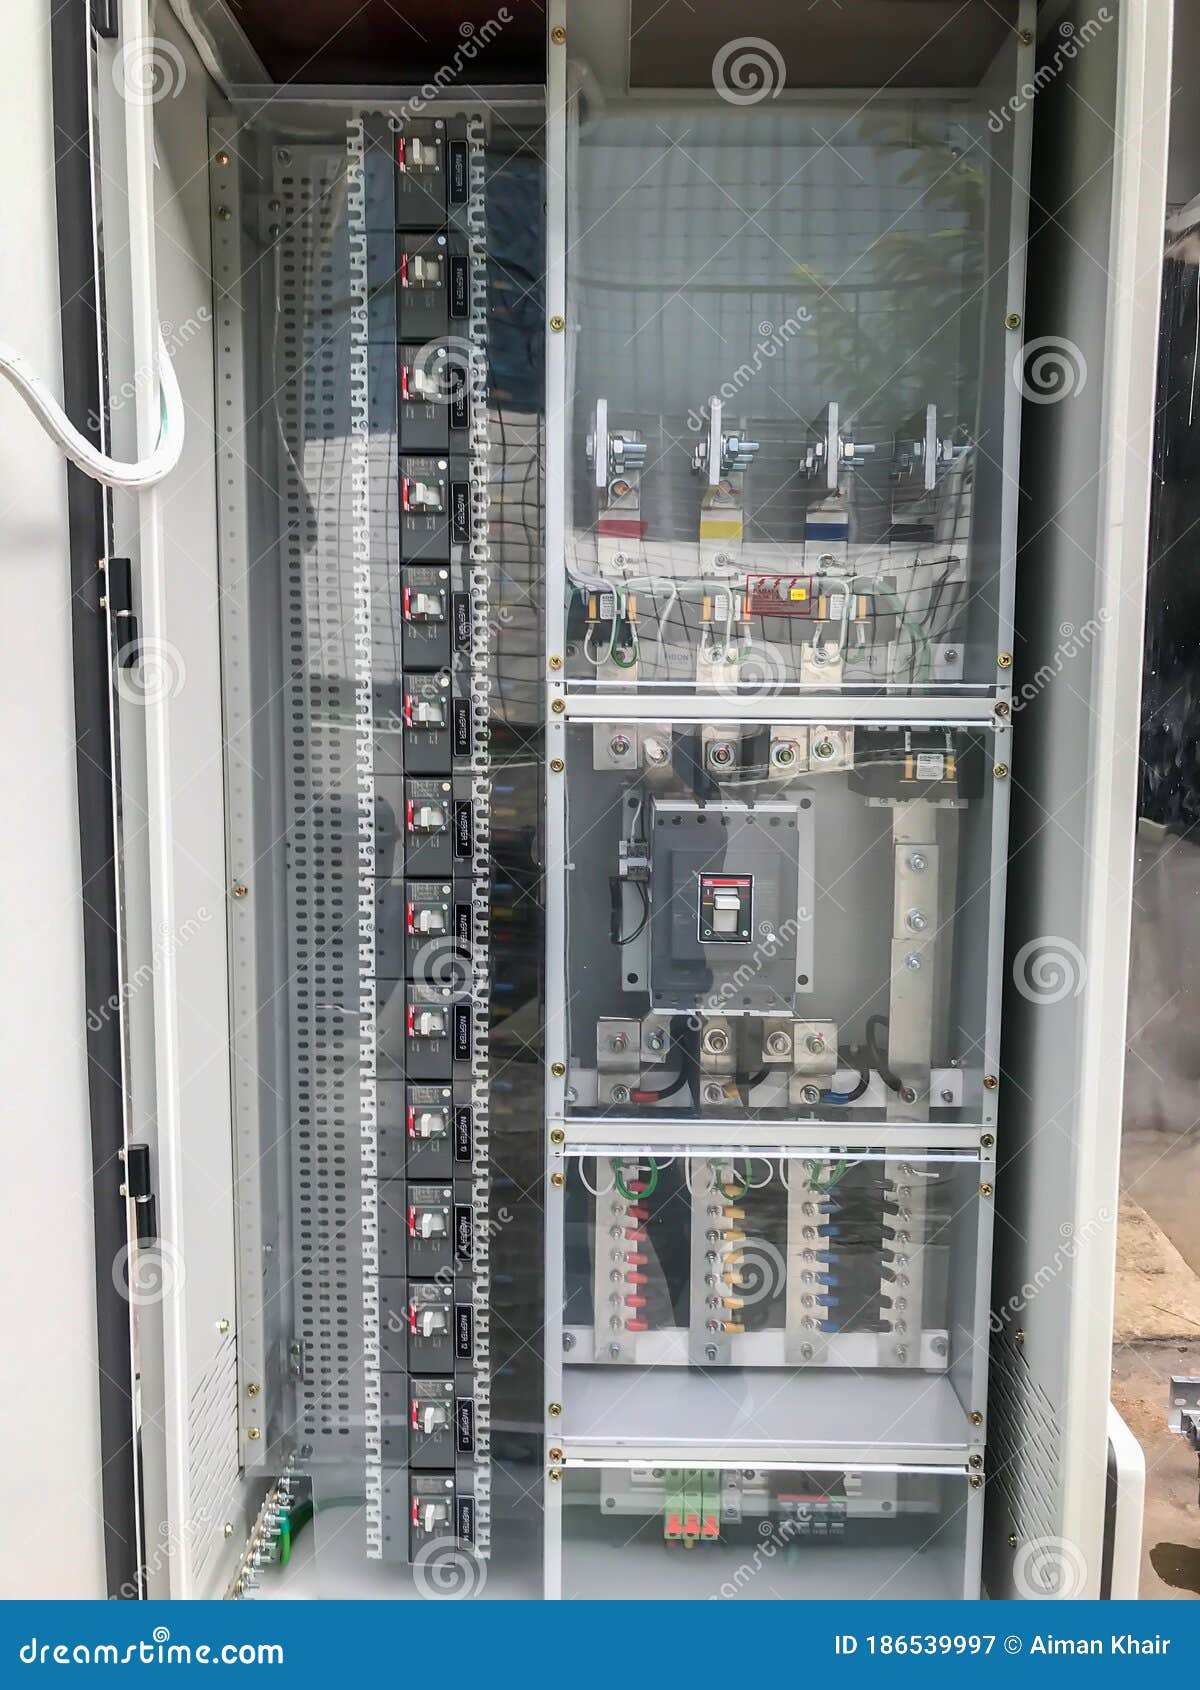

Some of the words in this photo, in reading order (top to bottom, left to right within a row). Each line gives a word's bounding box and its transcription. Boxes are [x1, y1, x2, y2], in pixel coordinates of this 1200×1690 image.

[455, 153, 463, 187] INVERTER
[456, 267, 464, 299] INVERTER
[457, 493, 466, 526] INVERTER
[458, 709, 467, 740] INVERTER
[459, 810, 468, 841] INVERTER
[459, 913, 468, 943] INVERTER
[459, 1015, 467, 1045] INVERTER
[459, 1115, 468, 1145] INVERTER
[460, 1314, 469, 1342] INVERTER
[461, 1408, 470, 1436] INVERTER
[462, 1506, 470, 1534] INVERTER
